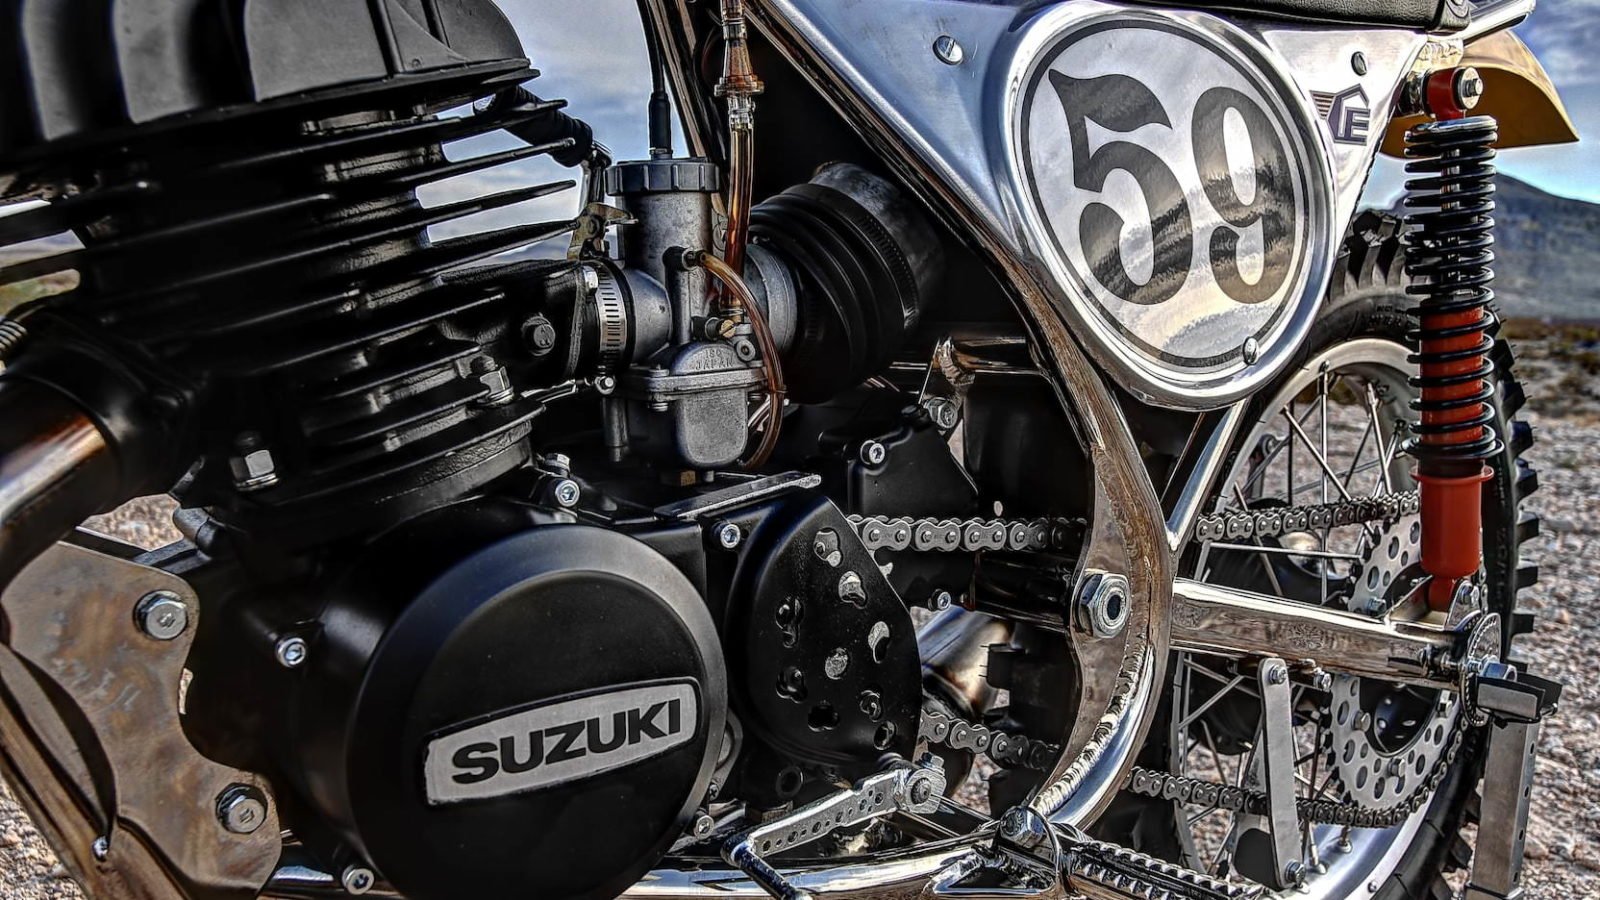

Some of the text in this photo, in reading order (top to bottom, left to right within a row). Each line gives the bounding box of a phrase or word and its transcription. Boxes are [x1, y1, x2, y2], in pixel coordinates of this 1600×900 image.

[1049, 69, 1296, 305] 59
[695, 353, 734, 370] JAPAN
[451, 698, 681, 785] SUZUKI
